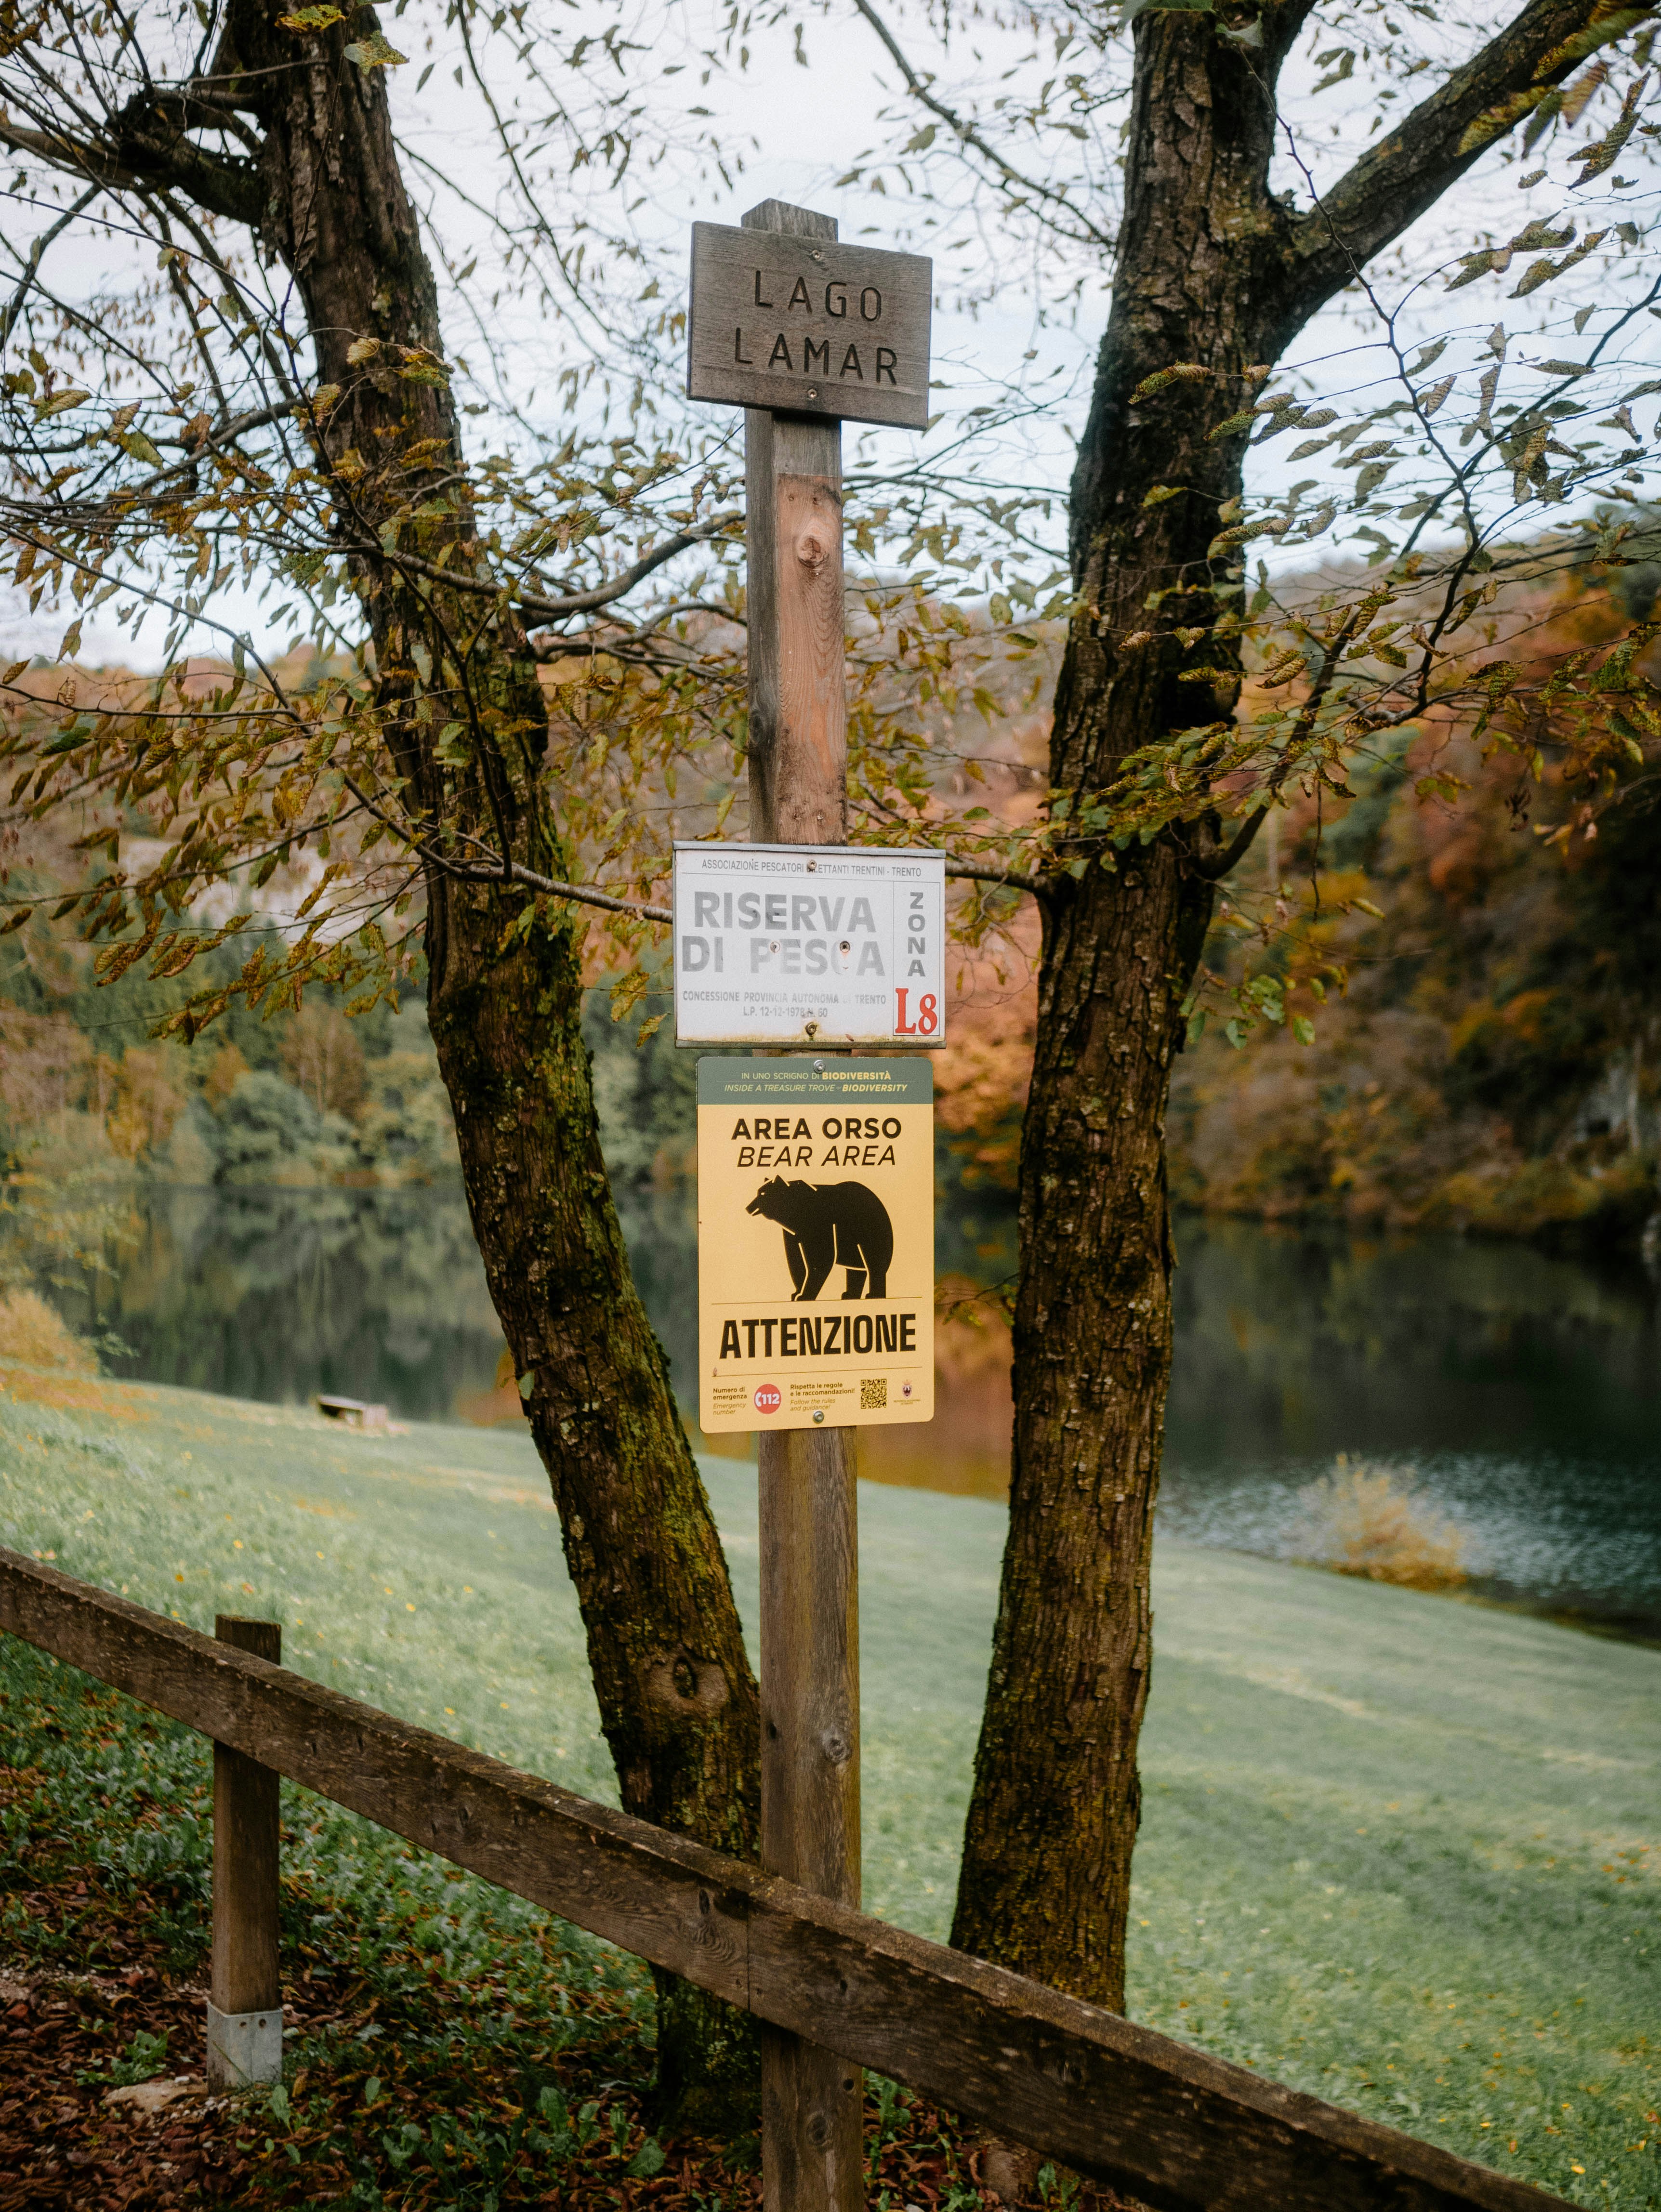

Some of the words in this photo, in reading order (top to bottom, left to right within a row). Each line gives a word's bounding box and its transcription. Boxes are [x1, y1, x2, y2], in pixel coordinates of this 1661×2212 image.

[754, 270, 882, 322] LAGO
[734, 327, 897, 385] LAMAR
[702, 859, 759, 871] ASSOCIAZIONE
[761, 862, 804, 872] PESCATORI
[806, 863, 849, 874] LETTANTI
[851, 865, 885, 876] TRENTINI
[892, 867, 922, 877] TRENTO
[694, 891, 876, 933] RISERVA
[907, 892, 926, 977] ZONA
[682, 935, 724, 973] DI
[683, 990, 740, 1002] CONCESSIONE
[744, 992, 788, 1003] PROVINCIA
[791, 993, 839, 1004] AUTONOMA
[855, 994, 886, 1005] TRENTO
[743, 1006, 758, 1016] L.P.
[759, 1006, 805, 1018] 12-12-1978
[895, 988, 937, 1035] L8
[822, 1070, 891, 1080] BIODIVERSITÀ
[724, 1084, 754, 1093] INSIDE
[764, 1084, 806, 1093] TREASURE
[808, 1084, 835, 1092] TROVE
[842, 1084, 908, 1092] BIODIVERSITY
[731, 1118, 813, 1140] AREA
[822, 1118, 902, 1139] ORSO
[737, 1146, 813, 1167] BEAR
[821, 1145, 896, 1166] AREA
[719, 1313, 916, 1359] ATTENZIONE
[762, 1393, 780, 1405] 112
